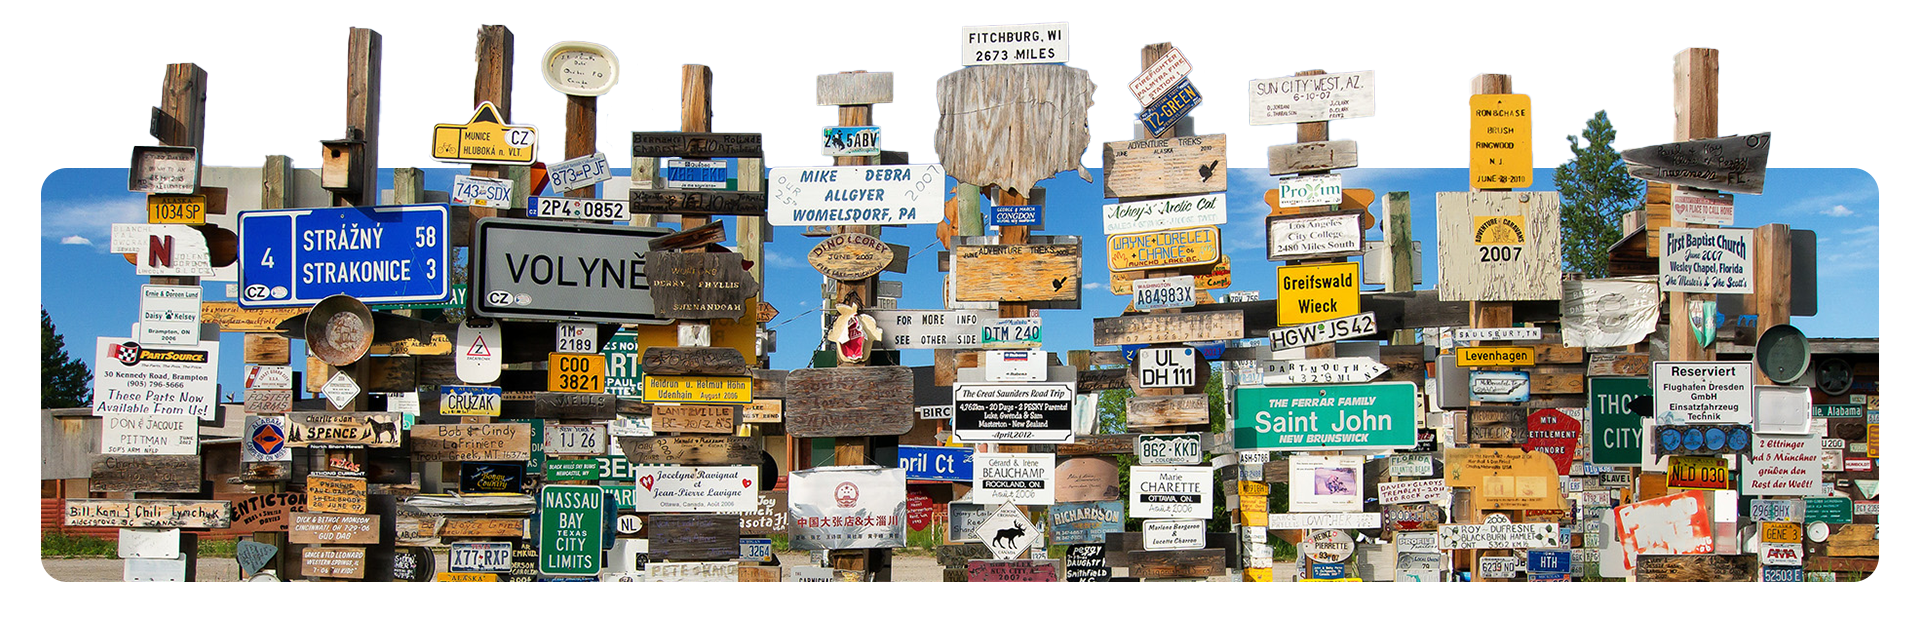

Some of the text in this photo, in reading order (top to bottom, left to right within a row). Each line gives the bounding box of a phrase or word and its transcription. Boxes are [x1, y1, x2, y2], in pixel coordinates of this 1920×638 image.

[969, 30, 1062, 43] FITCHBURG, WI
[976, 48, 1055, 61] 2673 MILES
[1135, 53, 1177, 89] FIREFIGHTER
[1257, 75, 1364, 96] SUN CITY WEST, AZ.
[1293, 92, 1331, 101] 6-10-07
[1146, 85, 1197, 129] T2-GREEN
[465, 130, 529, 145] MUNICE CZ
[1487, 127, 1514, 135] BRUSH
[847, 133, 878, 147] 5ABV
[1127, 137, 1202, 150] ADVENTURE TREKS
[1476, 141, 1515, 150] RINGWOOD
[463, 144, 522, 157] HLUBOKÁ VLT.
[800, 168, 912, 183] MIKE DEBRA
[825, 189, 885, 202] ALLGYER
[155, 204, 201, 220] 1034 SP
[541, 200, 624, 219] 2P4 0852
[1161, 197, 1217, 216] Arctic Cat
[793, 208, 917, 223] WOMELSDORF, PA
[997, 212, 1036, 221] CONGDON
[303, 222, 437, 252] STRÁŽNÝ 58
[1113, 229, 1211, 251] WAYNE LORELEI
[1310, 229, 1343, 243] College
[813, 236, 888, 256] DINO COREY
[1277, 240, 1355, 253] 2480 South
[1667, 233, 1747, 260] First Baptist Church
[261, 247, 274, 268] 4
[1139, 246, 1186, 261] CHANCE
[1480, 246, 1522, 263] 2007
[1684, 249, 1723, 261] June 2007
[303, 259, 437, 285] STRAKONICE 3
[505, 251, 650, 291] VOLYNĚ
[1669, 261, 1743, 275] Wesley Chapel, Florida
[698, 280, 740, 289] PHYLLIS
[1283, 273, 1353, 291] Greifswald
[248, 286, 266, 298] CZ
[1137, 287, 1192, 306] A84983X
[673, 303, 741, 311] SHENANDOAH
[1298, 299, 1338, 314] Wieck
[145, 312, 196, 322] Daisy Kelsey
[896, 315, 977, 325] FOR MORE INFO
[561, 326, 576, 337] 1M
[1352, 316, 1374, 334] 42
[894, 335, 977, 344] SEE OTHER SIDE
[984, 326, 1039, 341] DTM 240
[560, 339, 592, 351] 2189
[1156, 350, 1179, 366] UL
[1465, 350, 1528, 363] Levenhagen
[116, 371, 208, 383] Kennedy Road, Brampton
[1142, 368, 1193, 385] DH 111
[1671, 366, 1736, 377] Reserviert
[127, 380, 184, 389] (905) 796-5666
[560, 374, 598, 391] 3821
[650, 379, 726, 389] Heidrun Helmut
[1663, 383, 1745, 392] Flughafen Dresden
[108, 389, 205, 404] These Parts Now
[658, 389, 738, 401] Udenhain August 2006
[977, 389, 1065, 399] Great Saunders Road Trip
[1691, 393, 1717, 401] GmbH
[448, 395, 494, 411] CRUZAK
[1269, 396, 1377, 408] THE FERRAR FAMILY
[1669, 403, 1740, 413] Einsatzfahrzeug
[97, 401, 208, 417] Available From Us!
[1827, 405, 1862, 417] Alabama
[1255, 409, 1392, 433] Saint John
[1688, 412, 1721, 421] Technik
[146, 420, 184, 431] JACQUIE
[978, 420, 1008, 428] Masterton
[307, 426, 358, 440] SPENCE
[1279, 434, 1370, 444] NEW BRUNSWICK
[120, 434, 168, 446] PITTMAN
[1766, 440, 1804, 451] Ettringer
[935, 455, 954, 474] Ct
[656, 470, 738, 481] Jocelyne Ravignat
[983, 468, 1045, 479] BEAUCHAMP
[1160, 473, 1183, 482] Marie
[1672, 466, 1725, 484] NLD 030
[1758, 466, 1806, 477] grüßen den
[985, 481, 1026, 489] ROCKLAND,
[1140, 482, 1201, 493] CHARETTE
[1752, 479, 1813, 489] Rest der Welt!
[653, 488, 742, 500] Jean-Pierre Lavigne
[546, 492, 599, 510] NASSAU
[560, 512, 584, 530] BAY
[621, 519, 637, 531] NL
[1490, 524, 1536, 533] DUFRESNE
[1766, 528, 1788, 540] GENE
[1461, 532, 1536, 541] BLACKBURN HAMLET
[556, 537, 585, 552] CITY
[454, 550, 509, 566] X77 RXP
[548, 555, 592, 570] LIMITS
[1540, 556, 1558, 568] HTH
[1765, 570, 1792, 581] 52503
